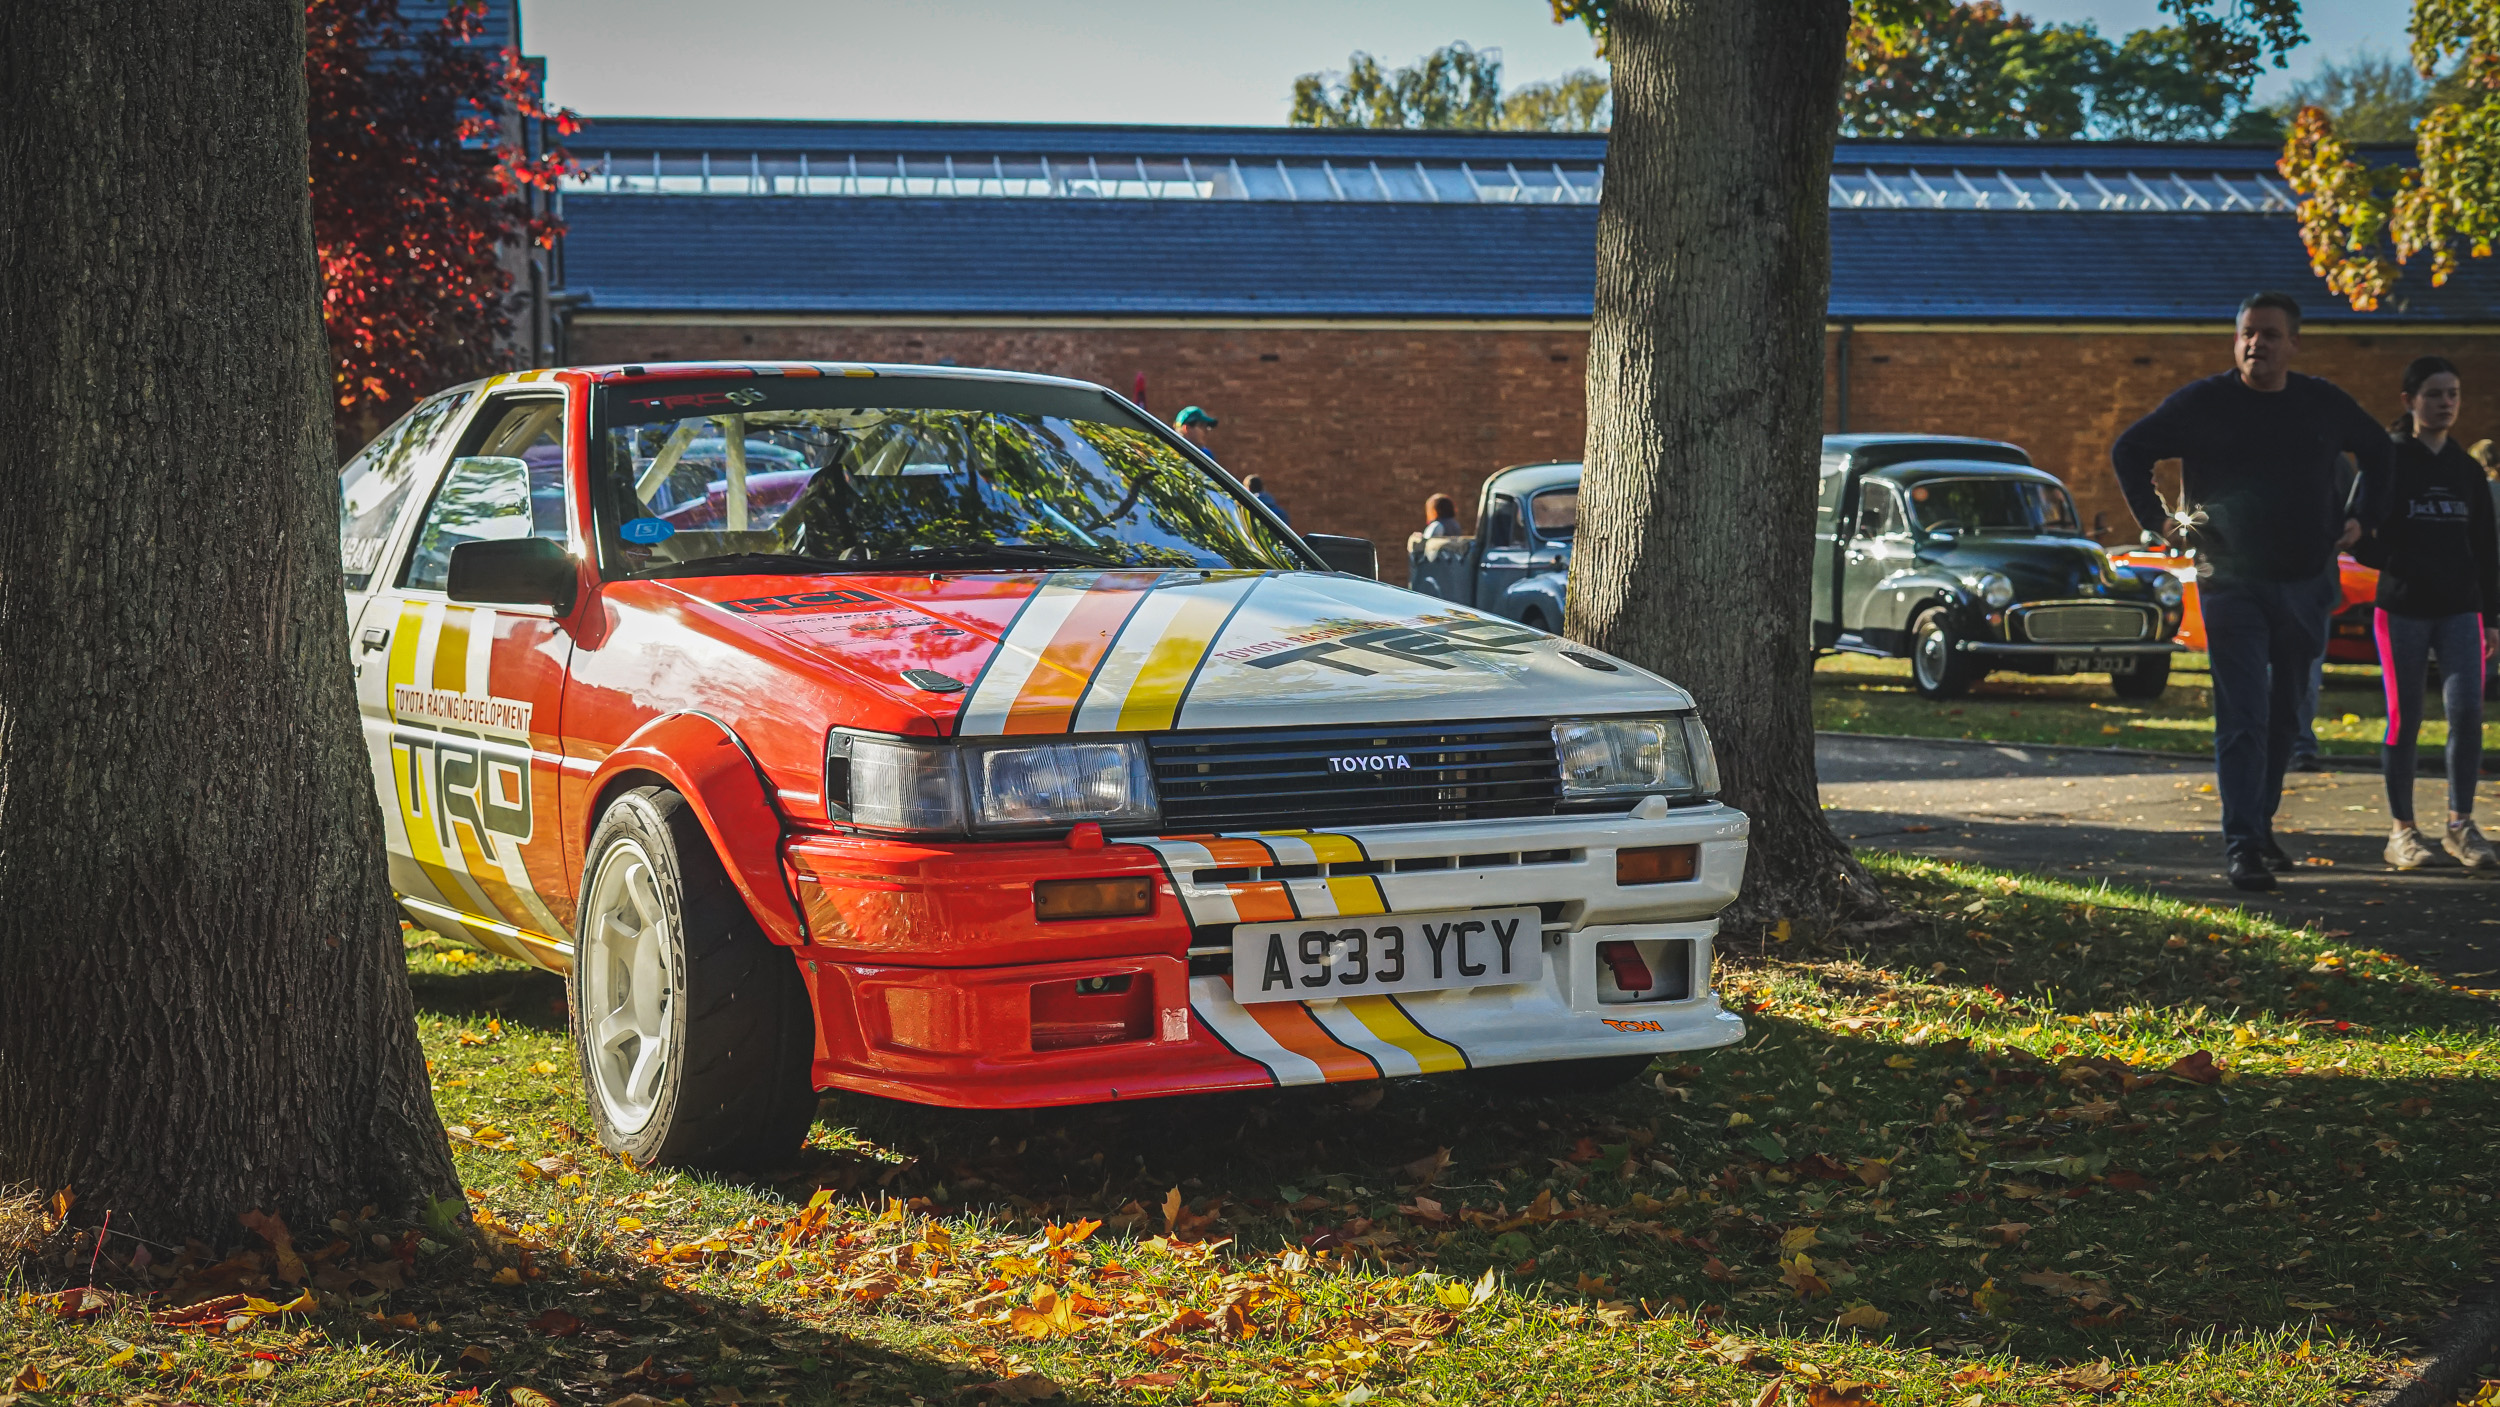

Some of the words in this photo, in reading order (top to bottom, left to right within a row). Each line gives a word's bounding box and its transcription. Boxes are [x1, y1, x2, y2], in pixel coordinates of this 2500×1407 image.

[1214, 640, 1290, 660] TOYOTA
[1286, 626, 1353, 644] RACING
[395, 689, 424, 712] TOYOTA
[427, 693, 459, 720] RACING
[462, 699, 530, 731] DEVELOPMENT
[1330, 755, 1411, 772] TOYOTA
[393, 718, 532, 862] TRD
[660, 853, 685, 991] TOYO
[1262, 926, 1405, 992] A933
[1422, 919, 1520, 979] YCY
[1600, 1018, 1665, 1033] TOW
